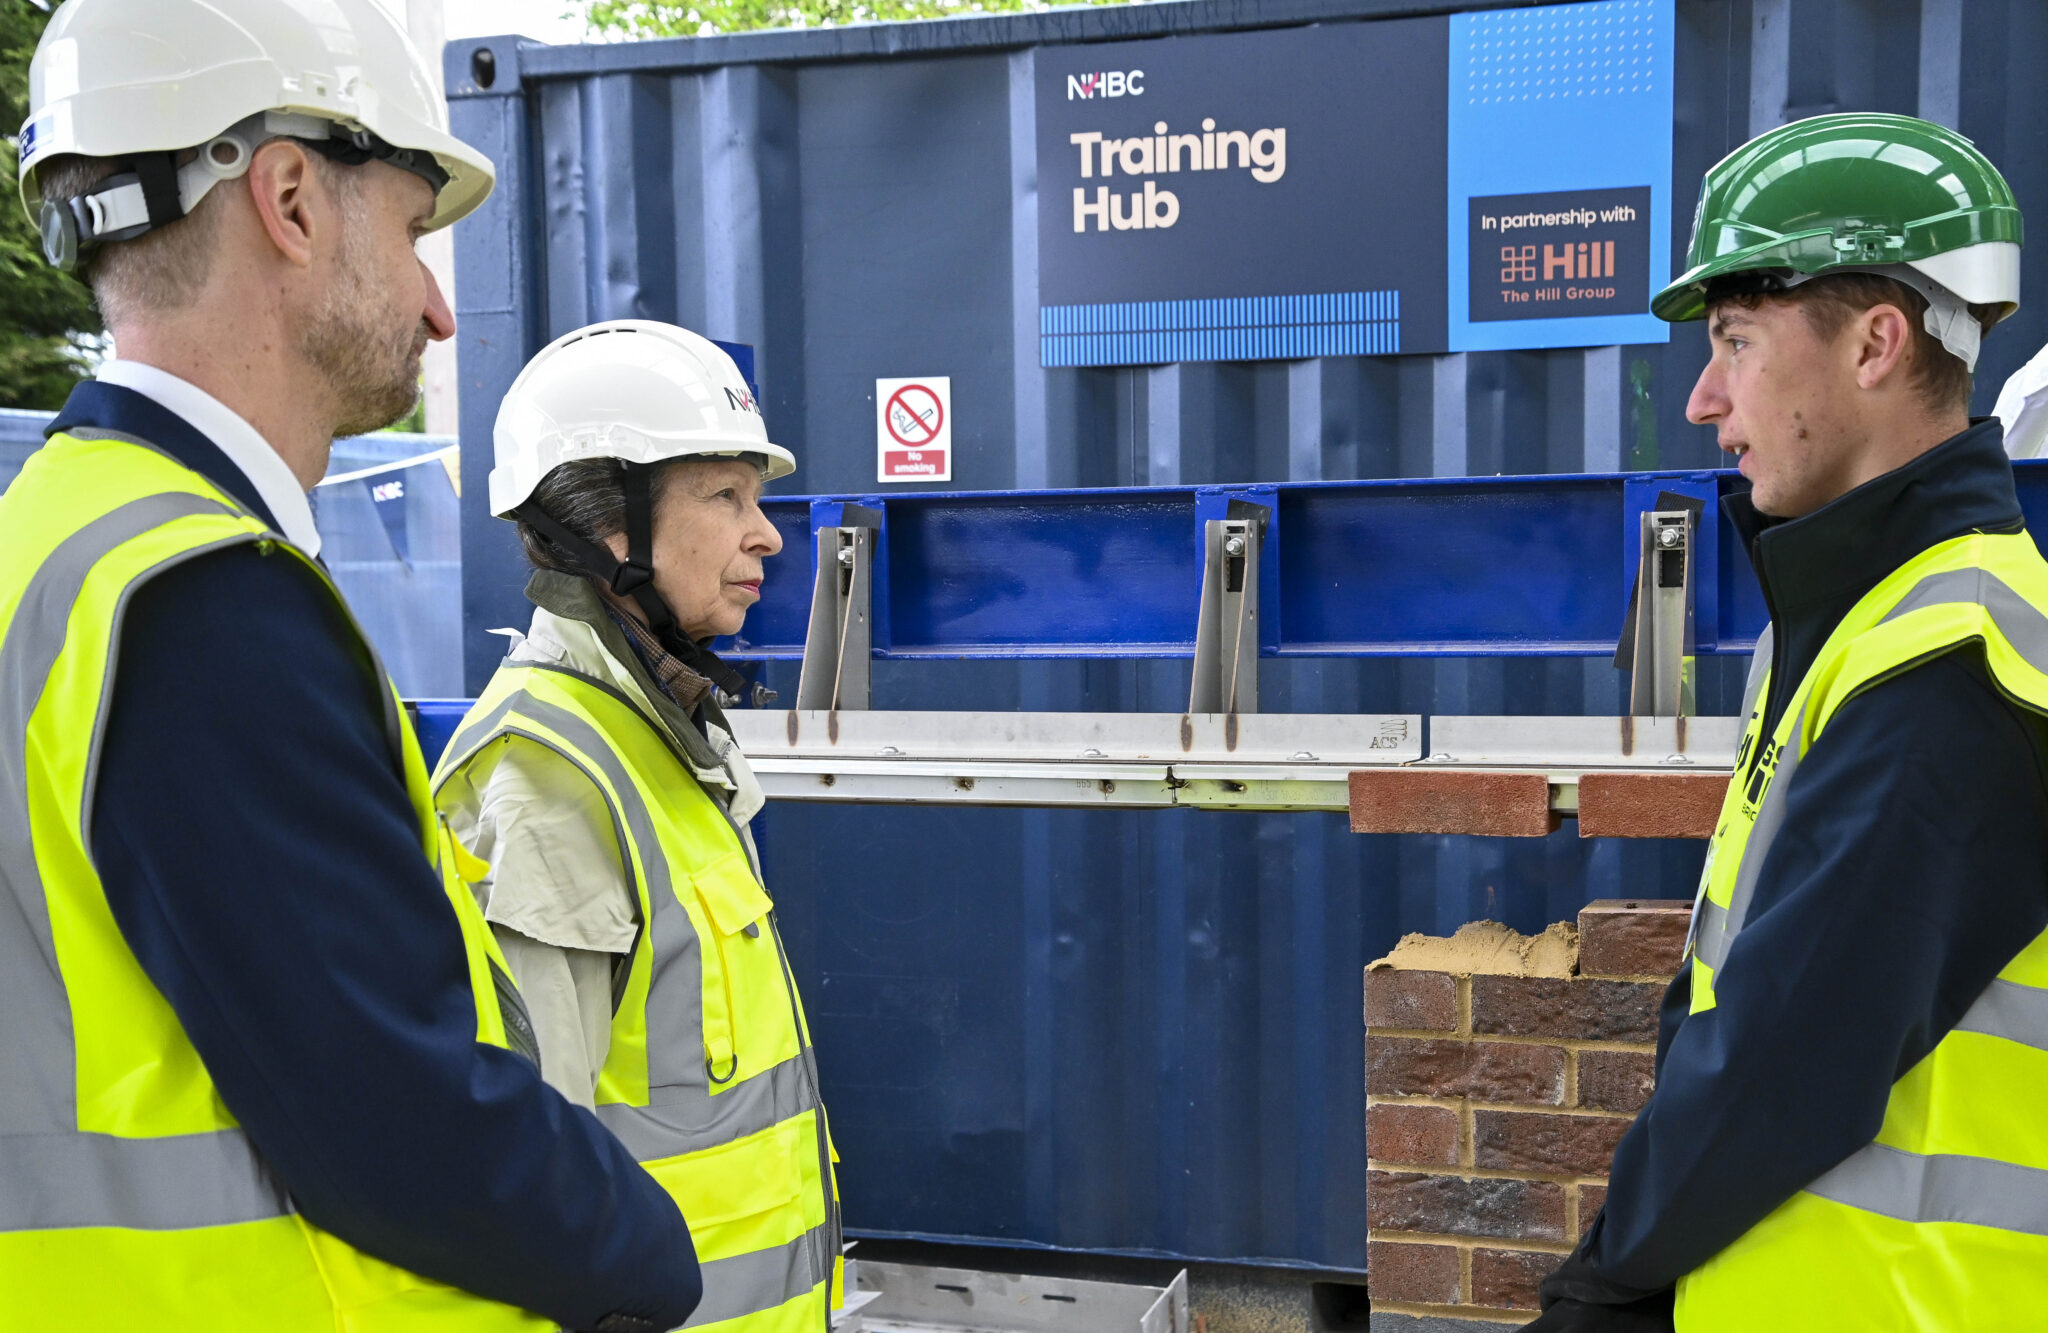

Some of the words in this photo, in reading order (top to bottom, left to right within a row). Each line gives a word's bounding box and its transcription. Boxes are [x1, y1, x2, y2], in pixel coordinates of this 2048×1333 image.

[1067, 69, 1145, 101] NHBC
[1069, 117, 1287, 184] Training
[1072, 180, 1180, 233] Hub
[1481, 215, 1497, 230] In
[1500, 208, 1597, 234] partnership
[1599, 205, 1636, 223] with
[1543, 240, 1615, 281] Hill
[1501, 290, 1530, 303] The
[1535, 287, 1561, 301] Hill
[1566, 286, 1616, 300] Group
[893, 462, 936, 475] smoking
[907, 451, 923, 462] No
[1369, 736, 1398, 749] ACS
